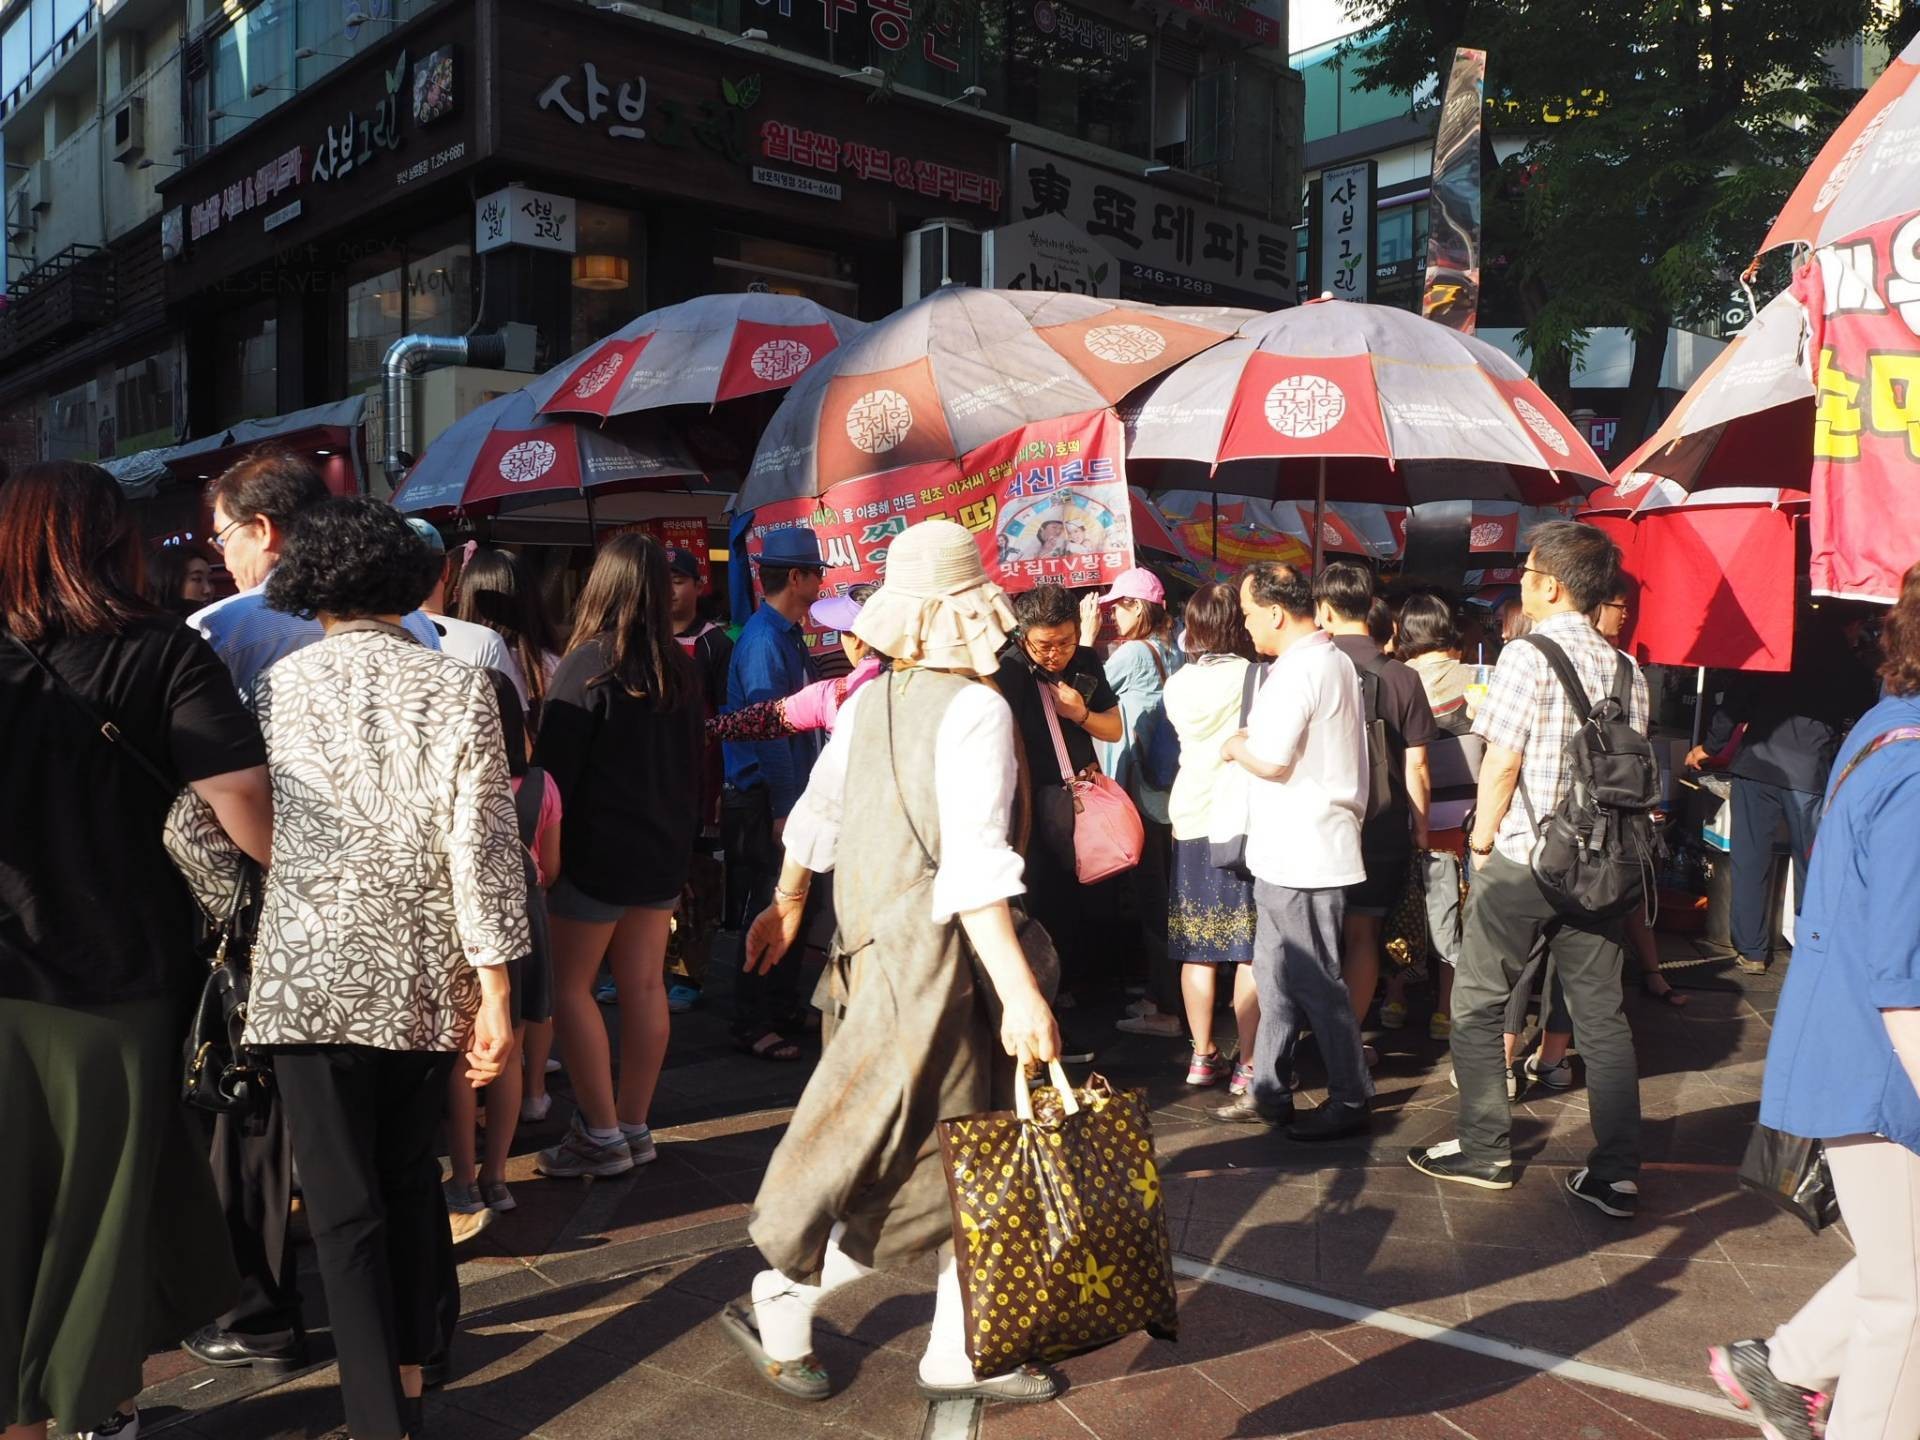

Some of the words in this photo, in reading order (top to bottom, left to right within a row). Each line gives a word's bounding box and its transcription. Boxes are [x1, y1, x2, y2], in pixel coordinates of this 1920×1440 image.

[761, 120, 841, 172] 월남쌈
[843, 142, 894, 181] 샤브
[895, 157, 921, 190] &
[915, 161, 1003, 212] 샐러드바
[521, 198, 552, 221] 샤브
[534, 221, 562, 241] 그린
[1330, 178, 1363, 292] 샤브그린
[1132, 264, 1214, 295] 246-1268
[857, 500, 890, 518] 이용해
[893, 494, 916, 511] 만든
[920, 487, 945, 504] 원조
[948, 475, 986, 494] 아저씨
